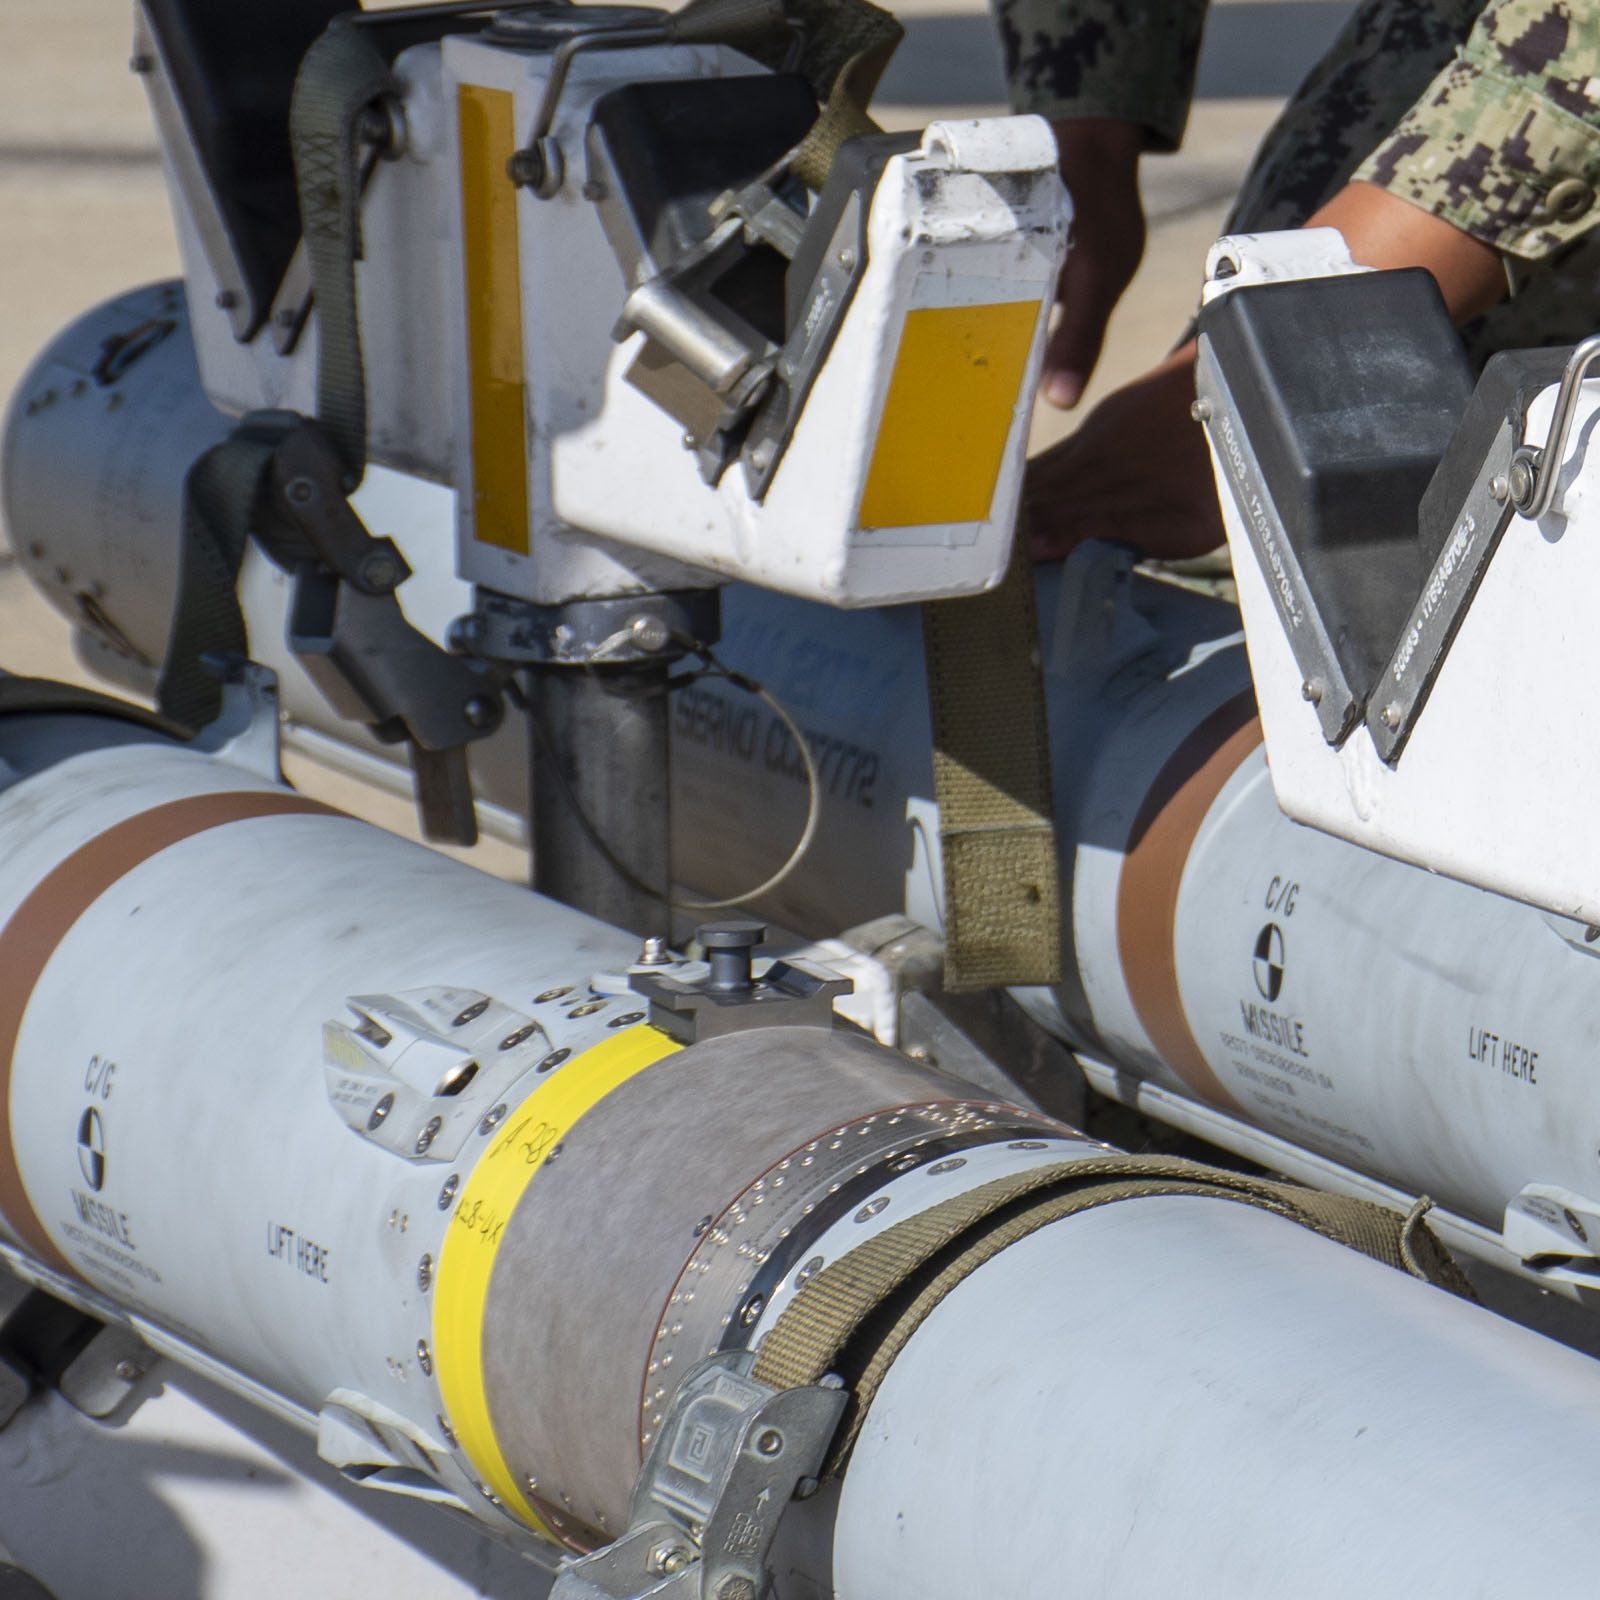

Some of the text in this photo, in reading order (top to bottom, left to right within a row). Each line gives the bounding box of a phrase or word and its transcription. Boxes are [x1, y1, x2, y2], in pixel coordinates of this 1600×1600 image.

[1264, 874, 1300, 918] C/G
[1240, 999, 1309, 1058] MISSILE
[1469, 1026, 1539, 1085] LIFT HERE
[84, 1053, 116, 1100] C/G
[266, 1219, 329, 1284] LIFT HERE
